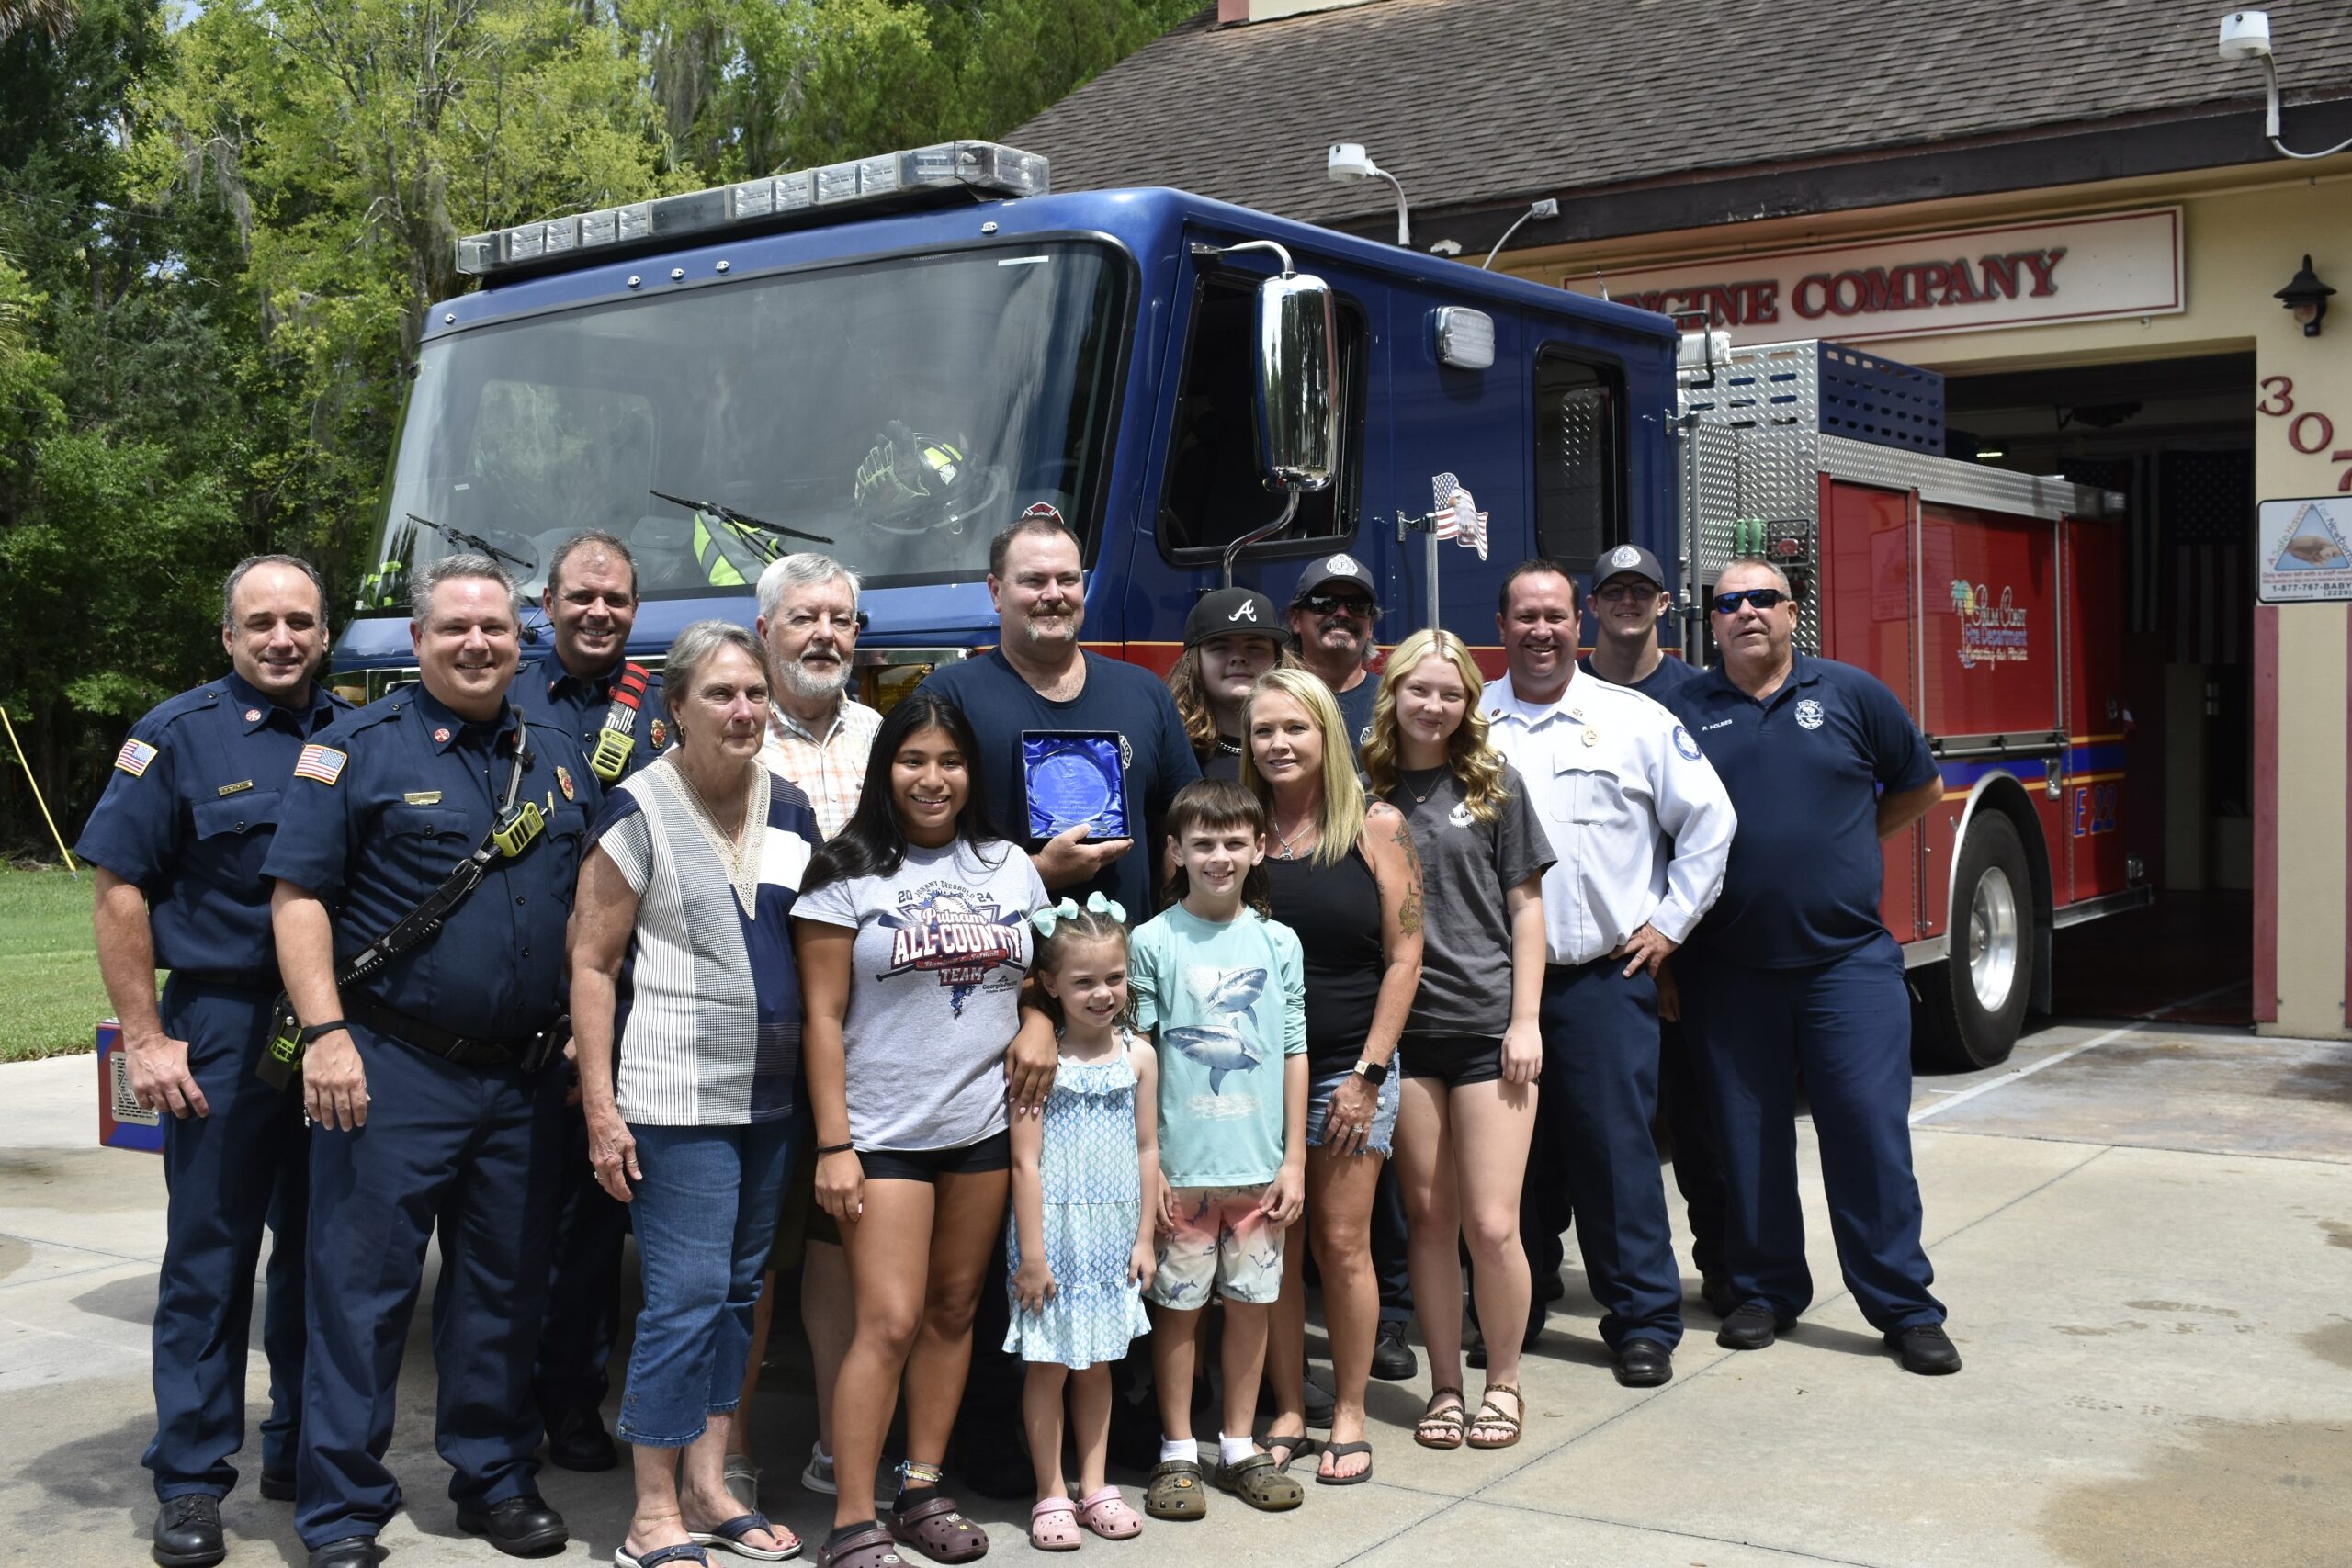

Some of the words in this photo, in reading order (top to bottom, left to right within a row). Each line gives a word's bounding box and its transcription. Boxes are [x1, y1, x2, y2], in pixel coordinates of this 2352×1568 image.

[1612, 278, 1779, 332] NGINE
[1791, 248, 2067, 319] COMPANY
[2272, 535, 2289, 557] Safe
[2284, 503, 2308, 535] Haven
[1228, 599, 1257, 623] A
[1709, 718, 1733, 730] HOLMES
[2074, 787, 2088, 838] E
[2090, 784, 2117, 835] 22
[898, 889, 913, 904] 20
[913, 880, 938, 898] JOHNNY
[976, 891, 995, 903] 24
[921, 908, 989, 927] Putnam
[893, 922, 1022, 966] ALL-COUNTY
[942, 966, 984, 982] TEAM
